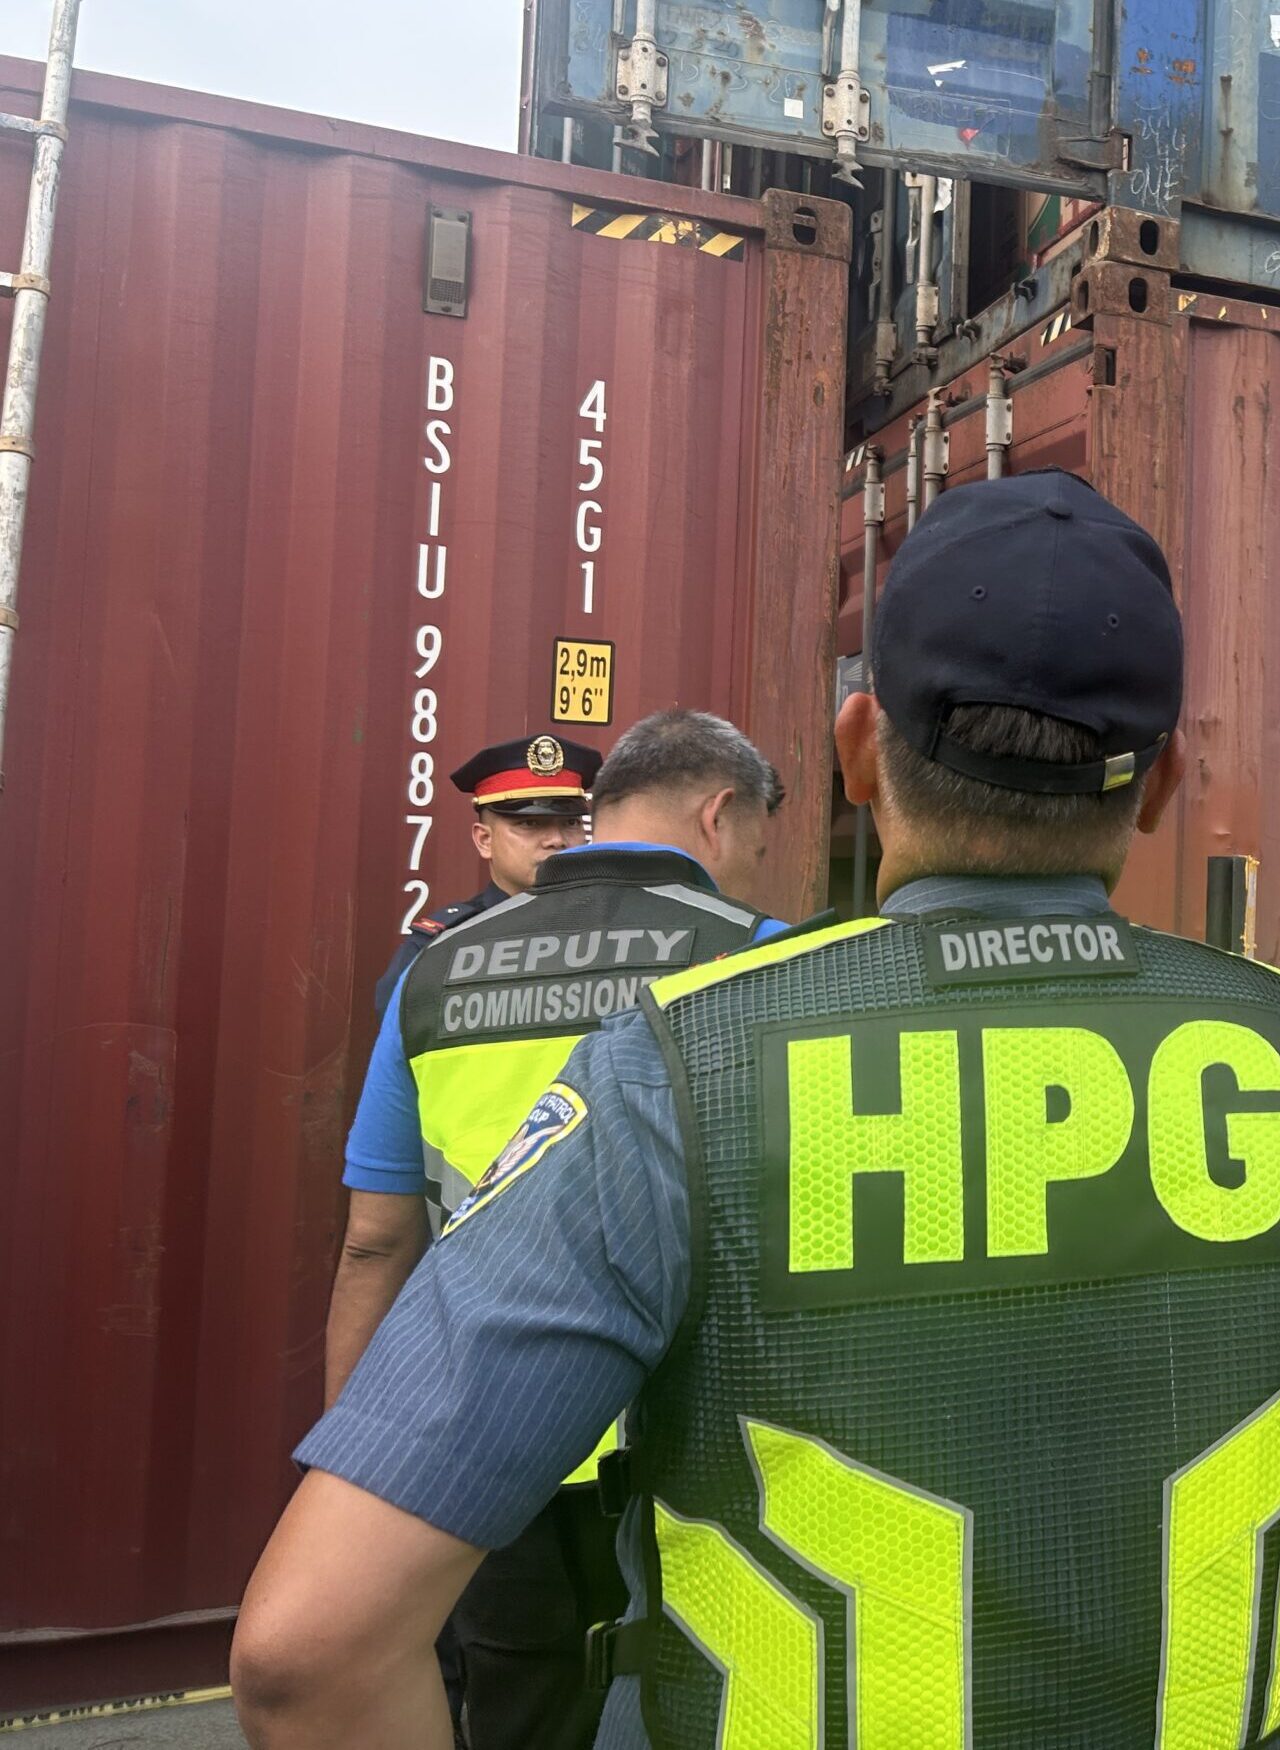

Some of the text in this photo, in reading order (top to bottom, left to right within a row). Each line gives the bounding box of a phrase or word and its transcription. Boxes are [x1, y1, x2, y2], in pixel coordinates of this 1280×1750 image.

[576, 380, 607, 614] 45G1
[400, 356, 455, 935] BSIU 98872
[559, 647, 607, 682] 2,9m
[448, 930, 690, 980] DEPUTY
[940, 924, 1126, 972] DIRECTOR
[443, 976, 659, 1032] COMMISSION
